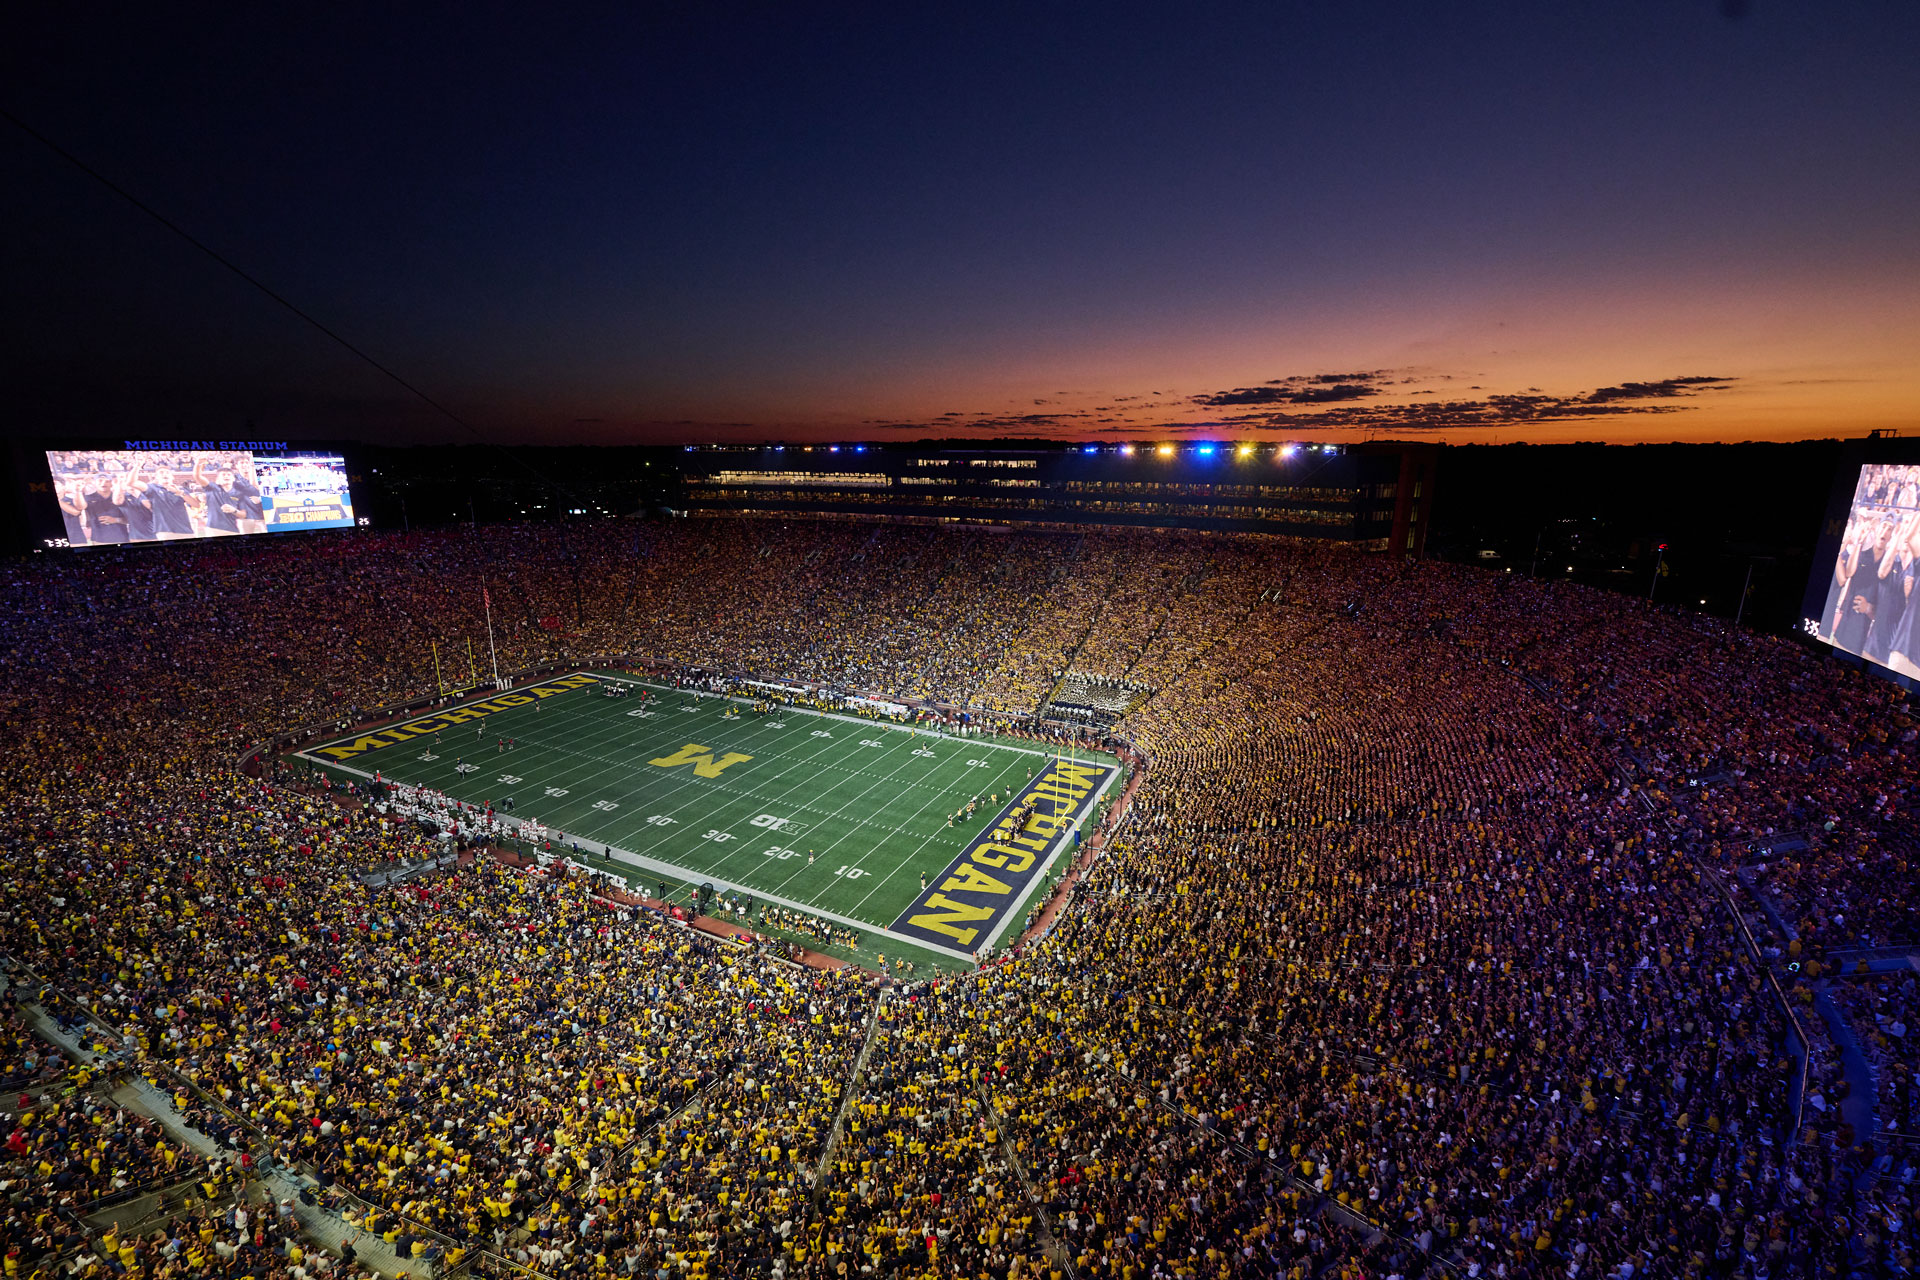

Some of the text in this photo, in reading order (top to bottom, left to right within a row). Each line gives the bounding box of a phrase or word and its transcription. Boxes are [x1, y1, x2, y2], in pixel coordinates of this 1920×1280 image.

[124, 440, 288, 450] MICHIGAN STADIUM
[28, 481, 48, 492] M
[358, 517, 369, 525] 25
[314, 674, 601, 760] MICHIGAN
[911, 749, 935, 757] 20
[647, 743, 755, 779] M
[966, 759, 988, 768] 10
[497, 774, 523, 785] 30
[544, 787, 570, 798] 40
[591, 800, 620, 811] 50
[646, 814, 674, 826] 40
[701, 829, 731, 843] 30
[763, 846, 795, 860] 20
[907, 760, 1106, 946] MICHIGAN
[833, 865, 865, 880] 10
